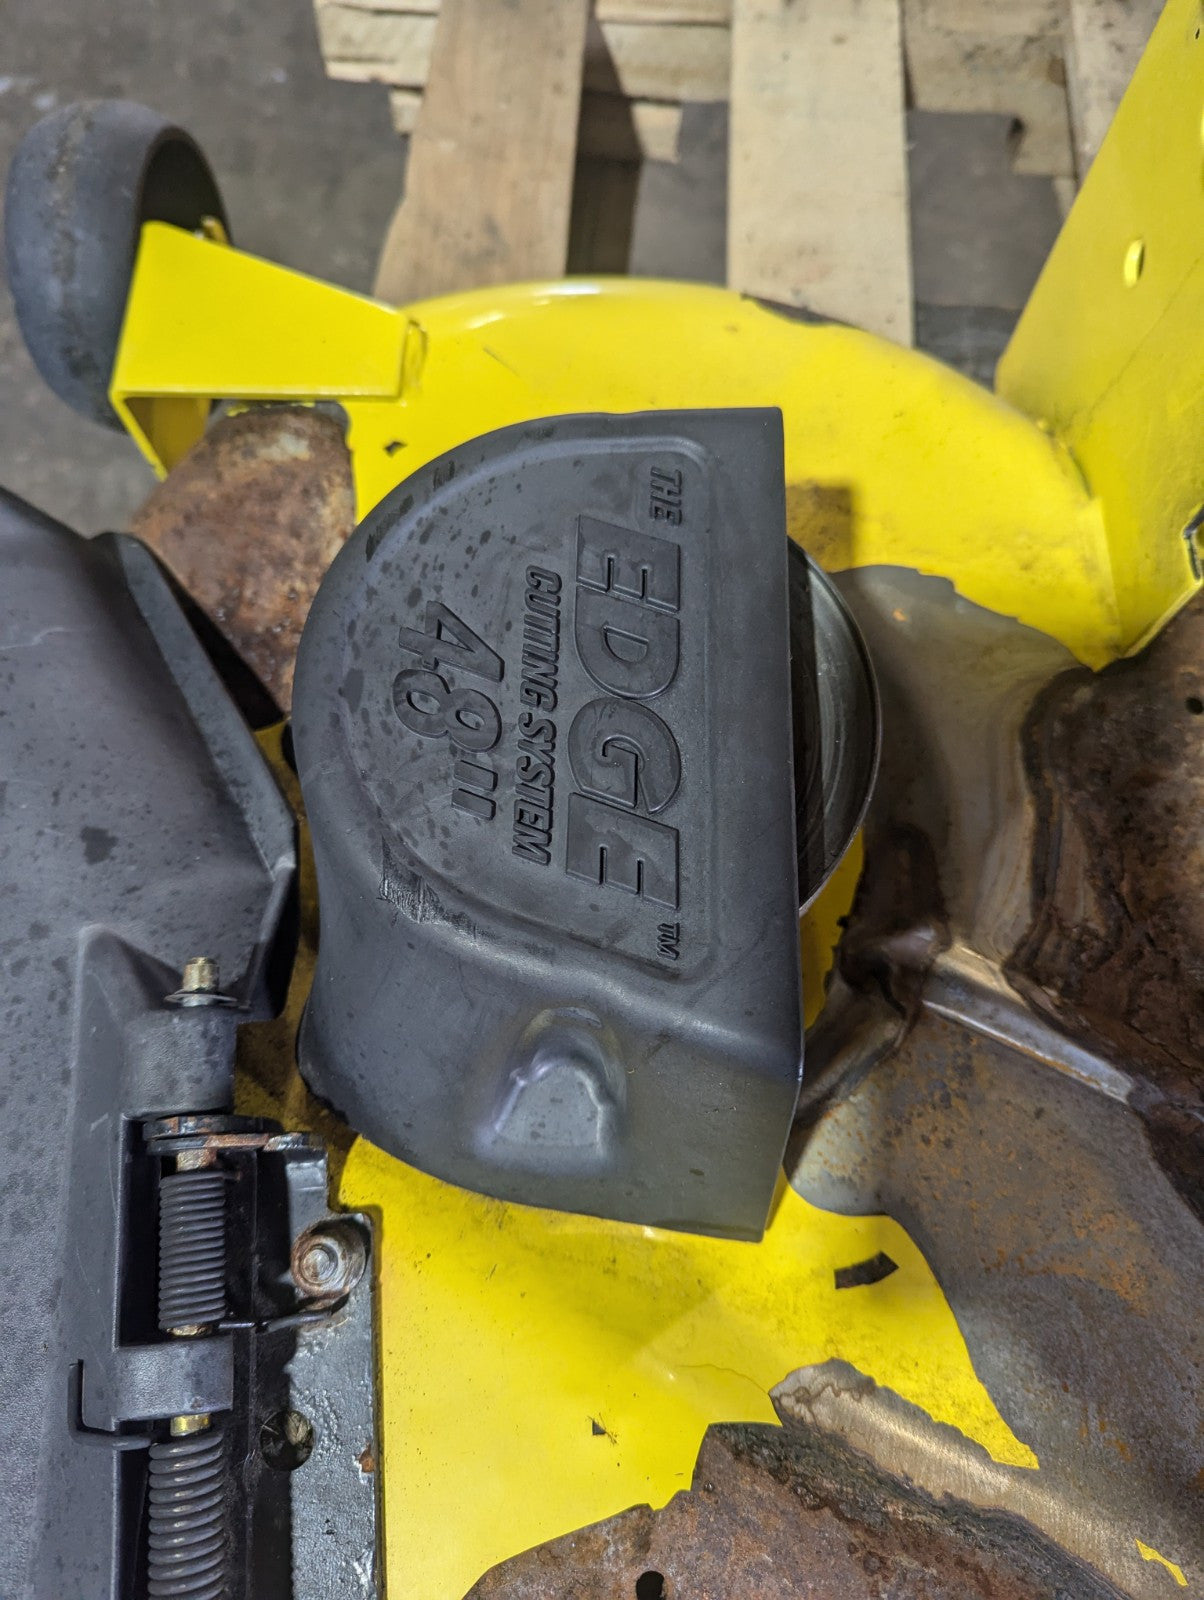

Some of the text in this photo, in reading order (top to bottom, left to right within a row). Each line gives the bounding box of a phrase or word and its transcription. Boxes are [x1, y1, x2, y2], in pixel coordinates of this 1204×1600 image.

[650, 465, 683, 527] THE
[512, 565, 562, 866] CUTTING SYSTEM
[566, 513, 682, 911] EDGE
